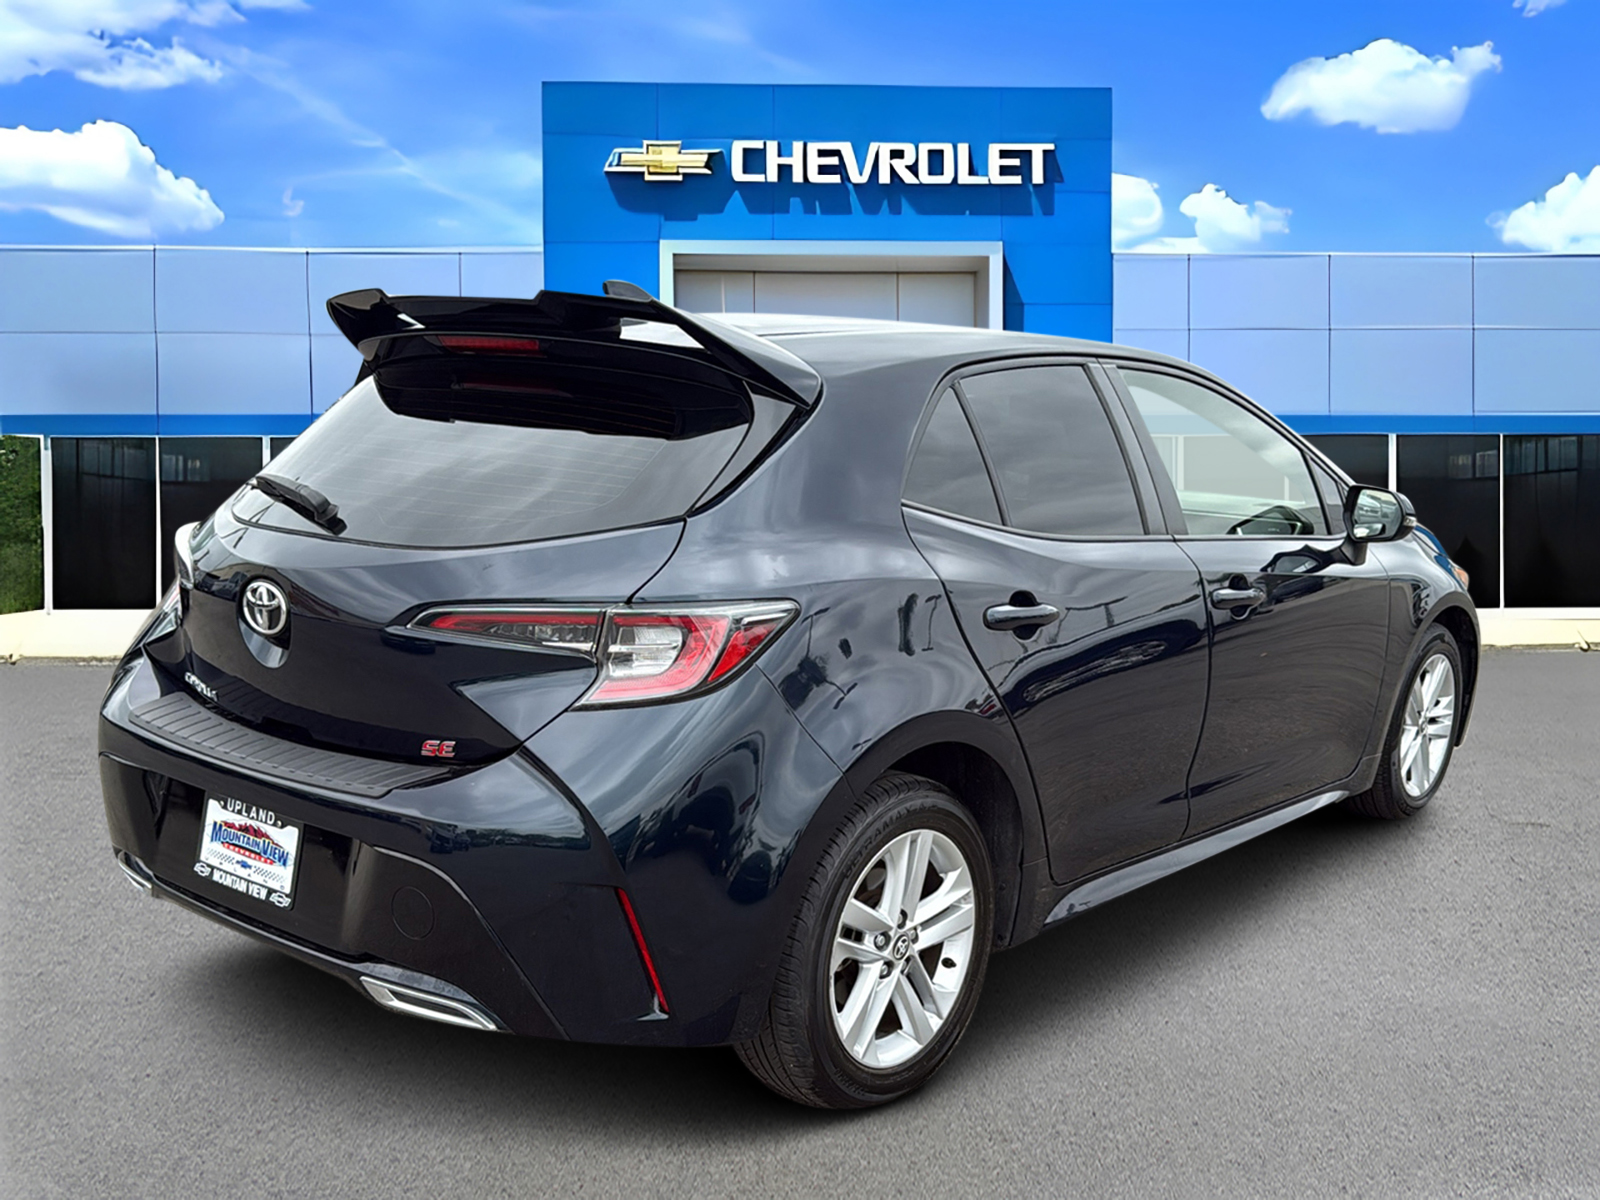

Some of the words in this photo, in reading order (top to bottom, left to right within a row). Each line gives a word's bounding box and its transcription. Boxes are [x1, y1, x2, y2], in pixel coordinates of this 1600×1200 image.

[731, 140, 1055, 184] CHEVROLET
[421, 740, 456, 757] SE
[227, 798, 275, 825] UPLAND
[249, 882, 268, 900] VIEW
